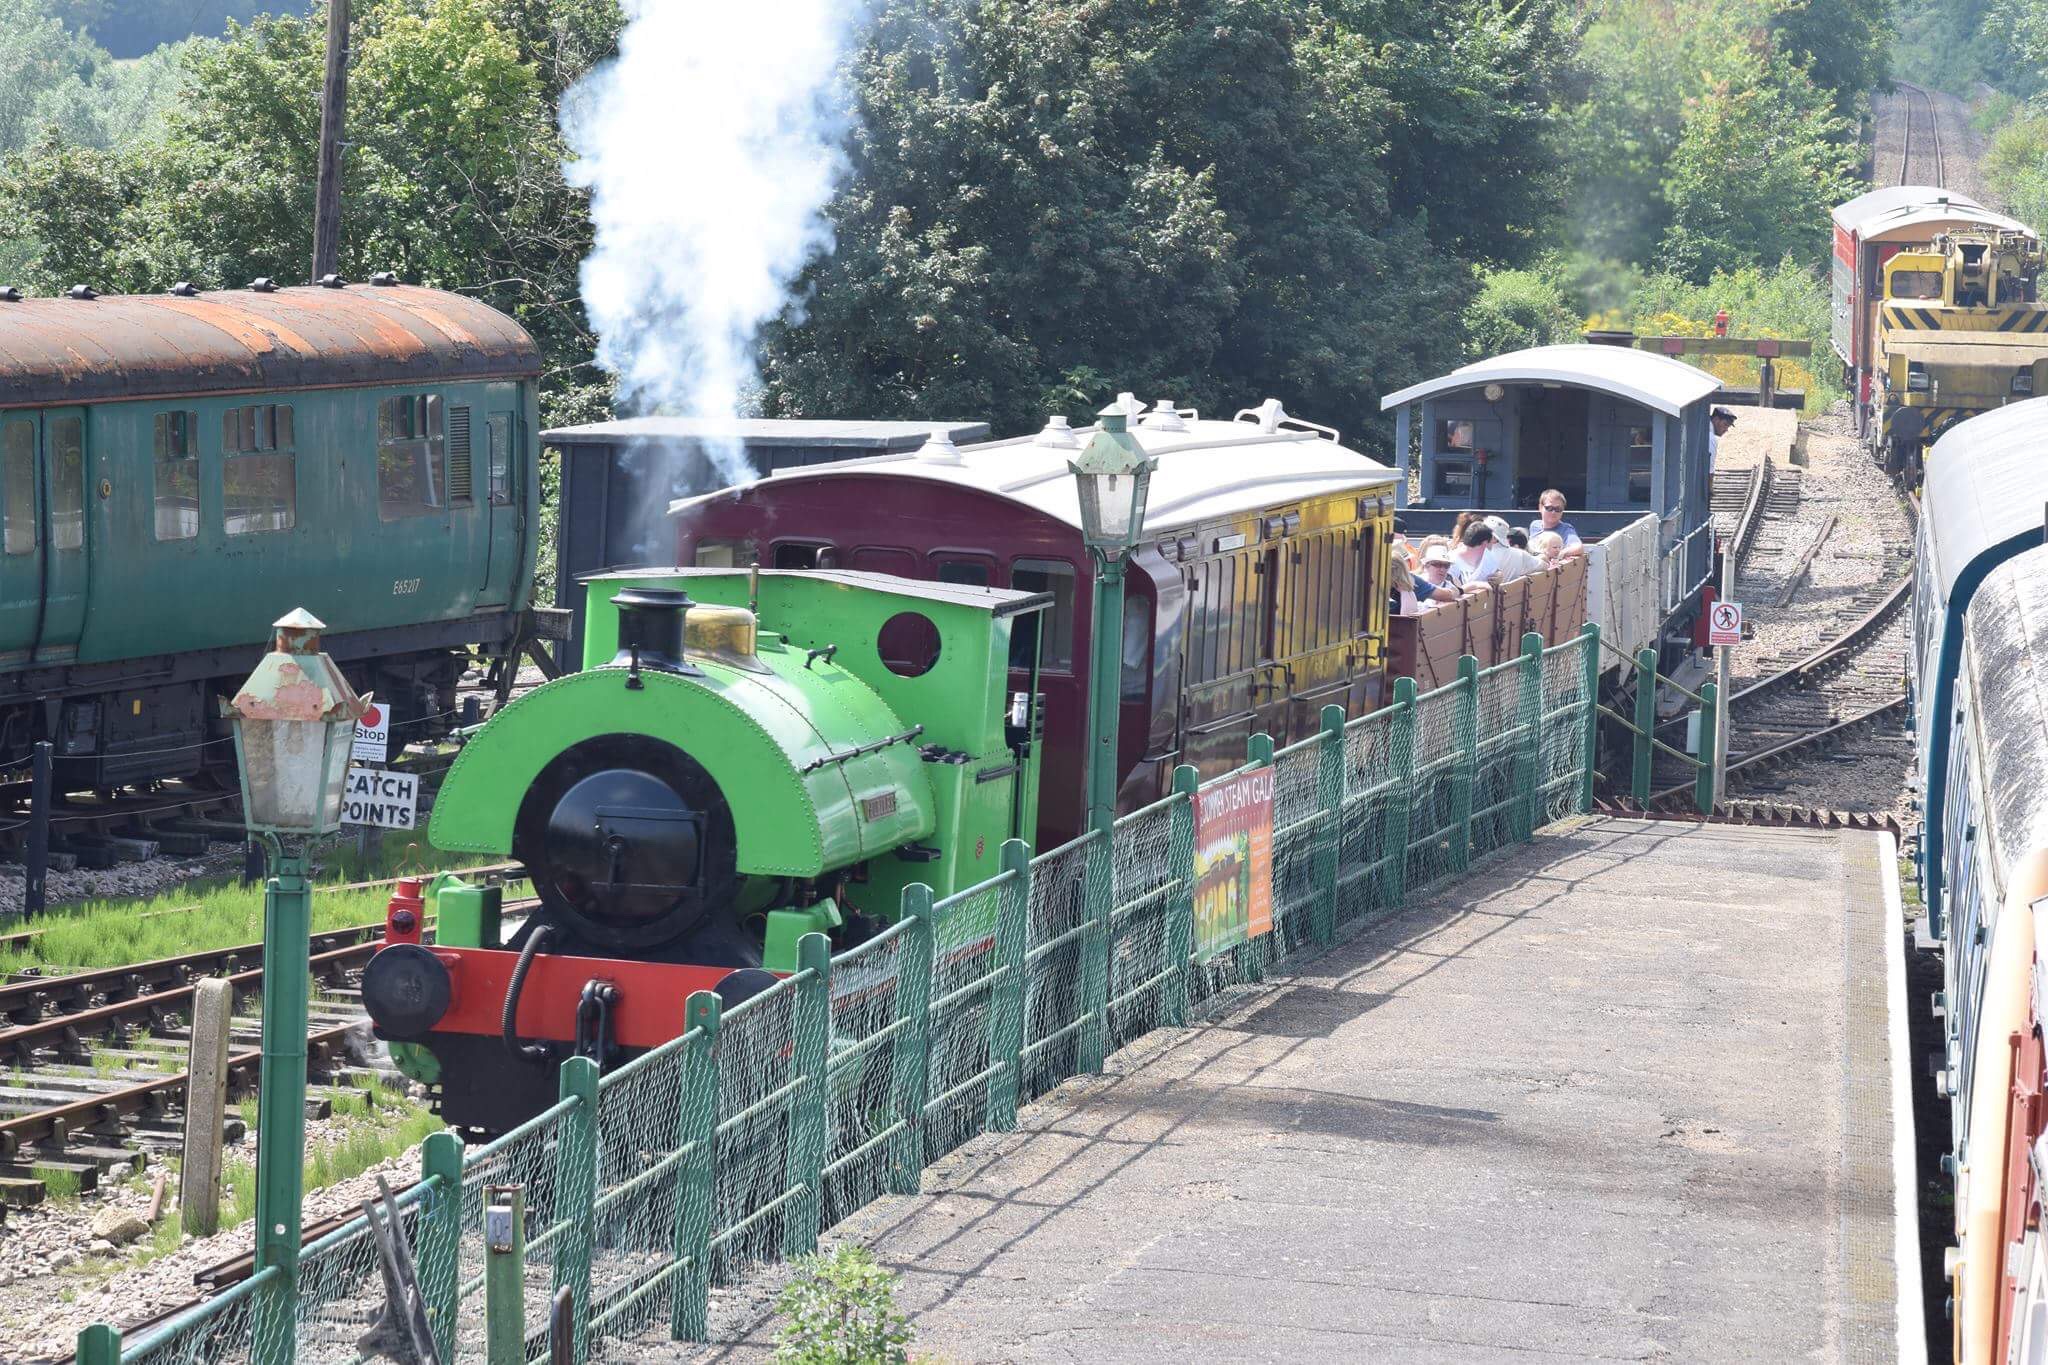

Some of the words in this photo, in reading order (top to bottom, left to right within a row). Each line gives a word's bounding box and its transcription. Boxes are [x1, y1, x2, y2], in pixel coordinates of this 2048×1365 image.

[355, 728, 386, 742] Stop
[1225, 779, 1250, 813] STEAM
[1252, 774, 1275, 804] GALA
